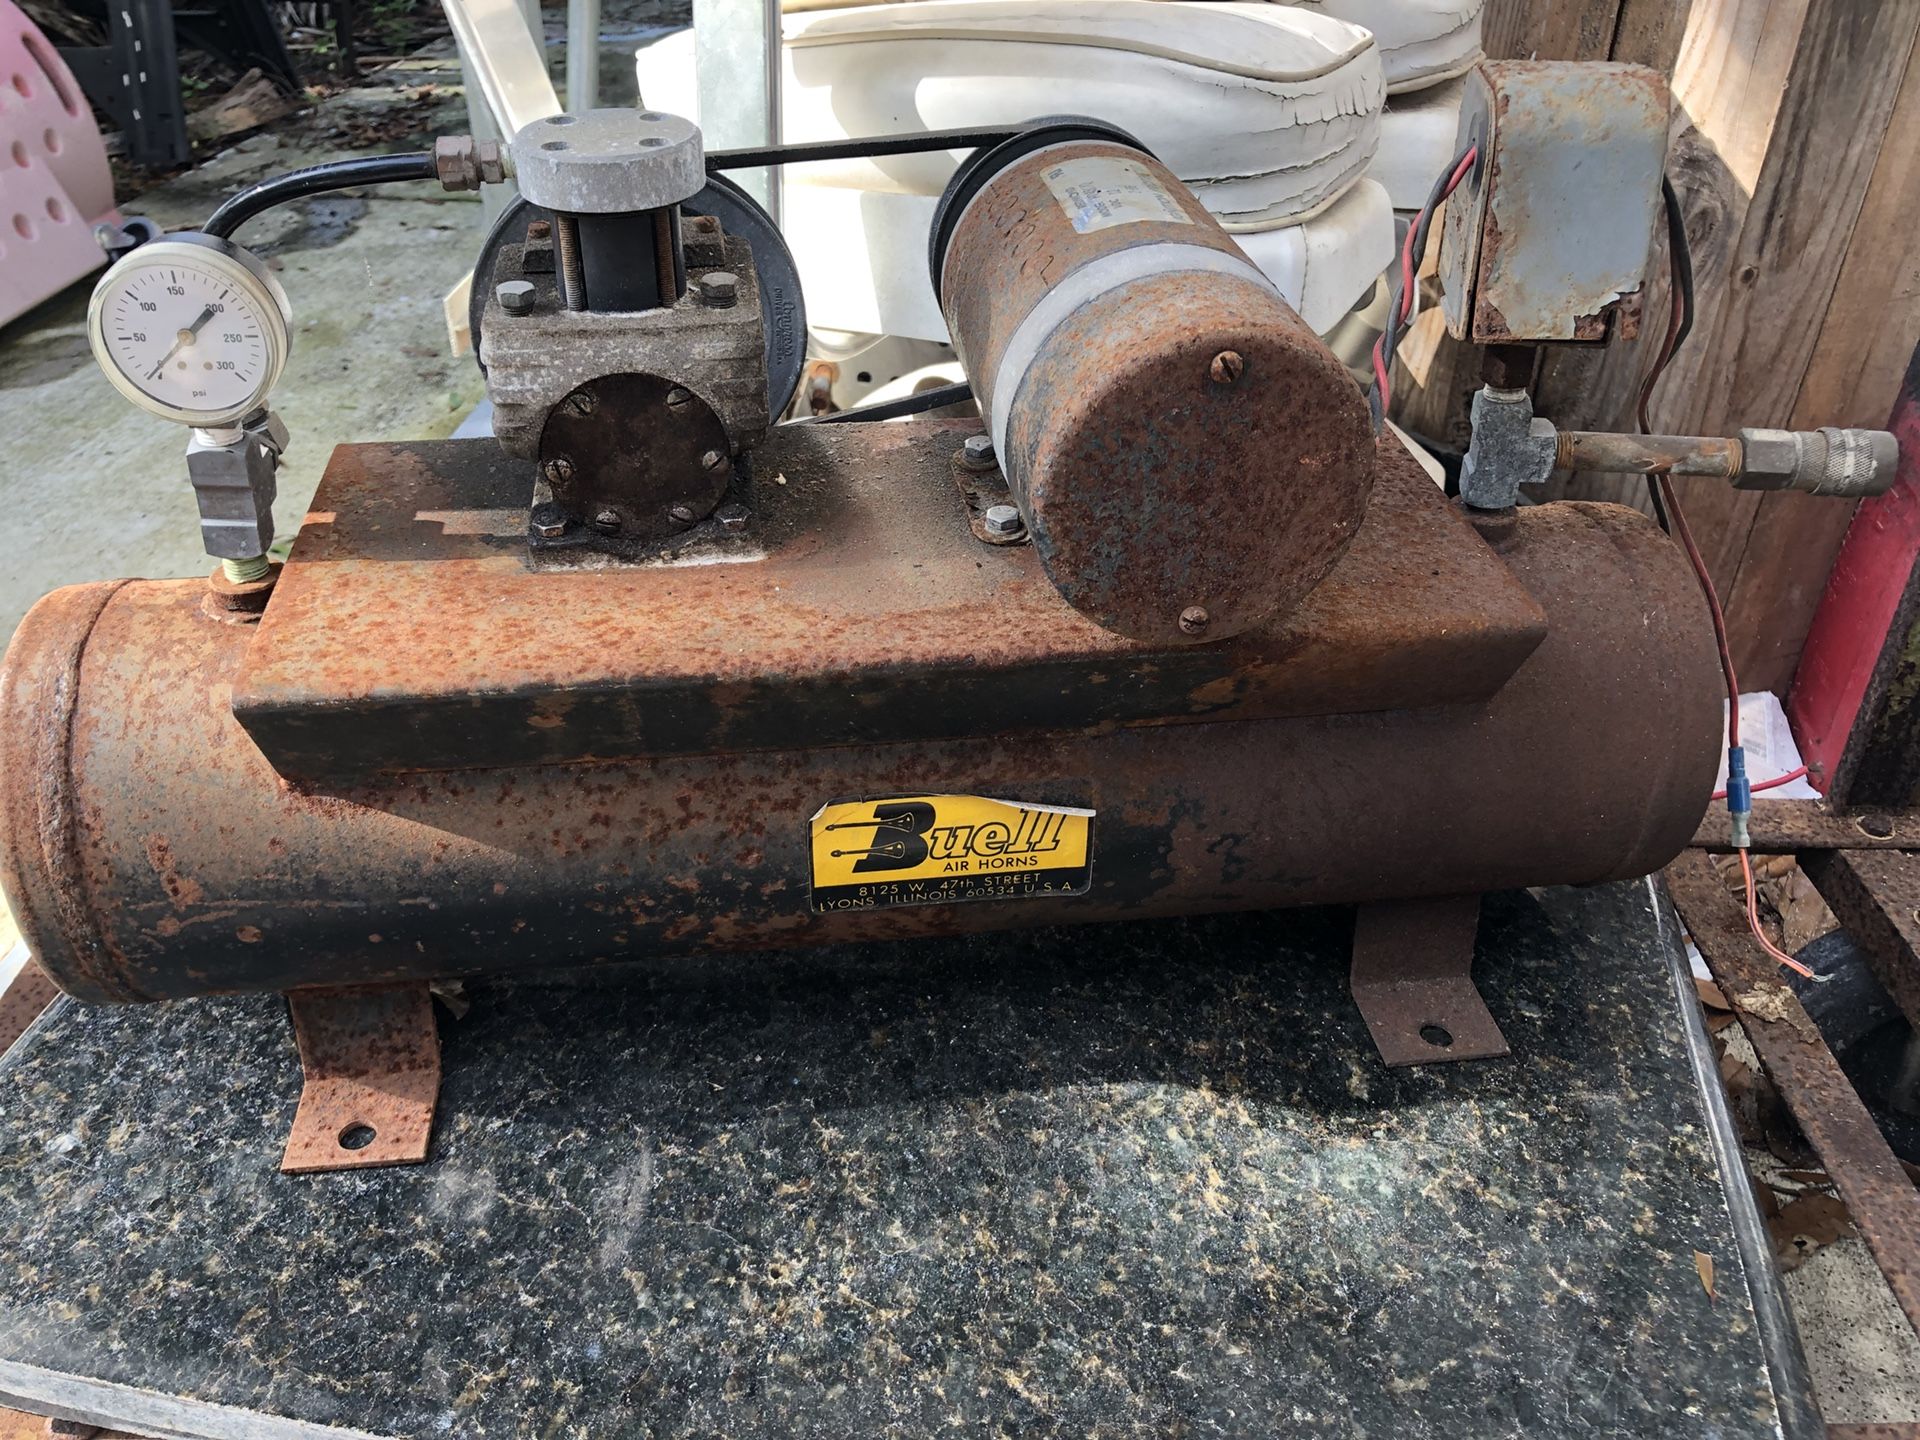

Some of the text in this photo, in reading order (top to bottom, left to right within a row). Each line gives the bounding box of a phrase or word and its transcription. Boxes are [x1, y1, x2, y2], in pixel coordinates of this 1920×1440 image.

[166, 286, 185, 296] 150
[139, 302, 156, 312] 100
[205, 303, 224, 313] 200
[133, 333, 146, 342] 50
[223, 334, 242, 343] 250
[216, 361, 235, 370] 300
[192, 389, 207, 398] psi
[852, 802, 1068, 873] Buell
[943, 855, 1038, 872] AIR HORNS
[859, 884, 898, 897] 8125
[940, 878, 974, 890] 47th
[984, 873, 1040, 887] STREET
[819, 896, 875, 912] LYONS
[890, 890, 957, 904] ILLINOIS
[966, 886, 1015, 897] 60534
